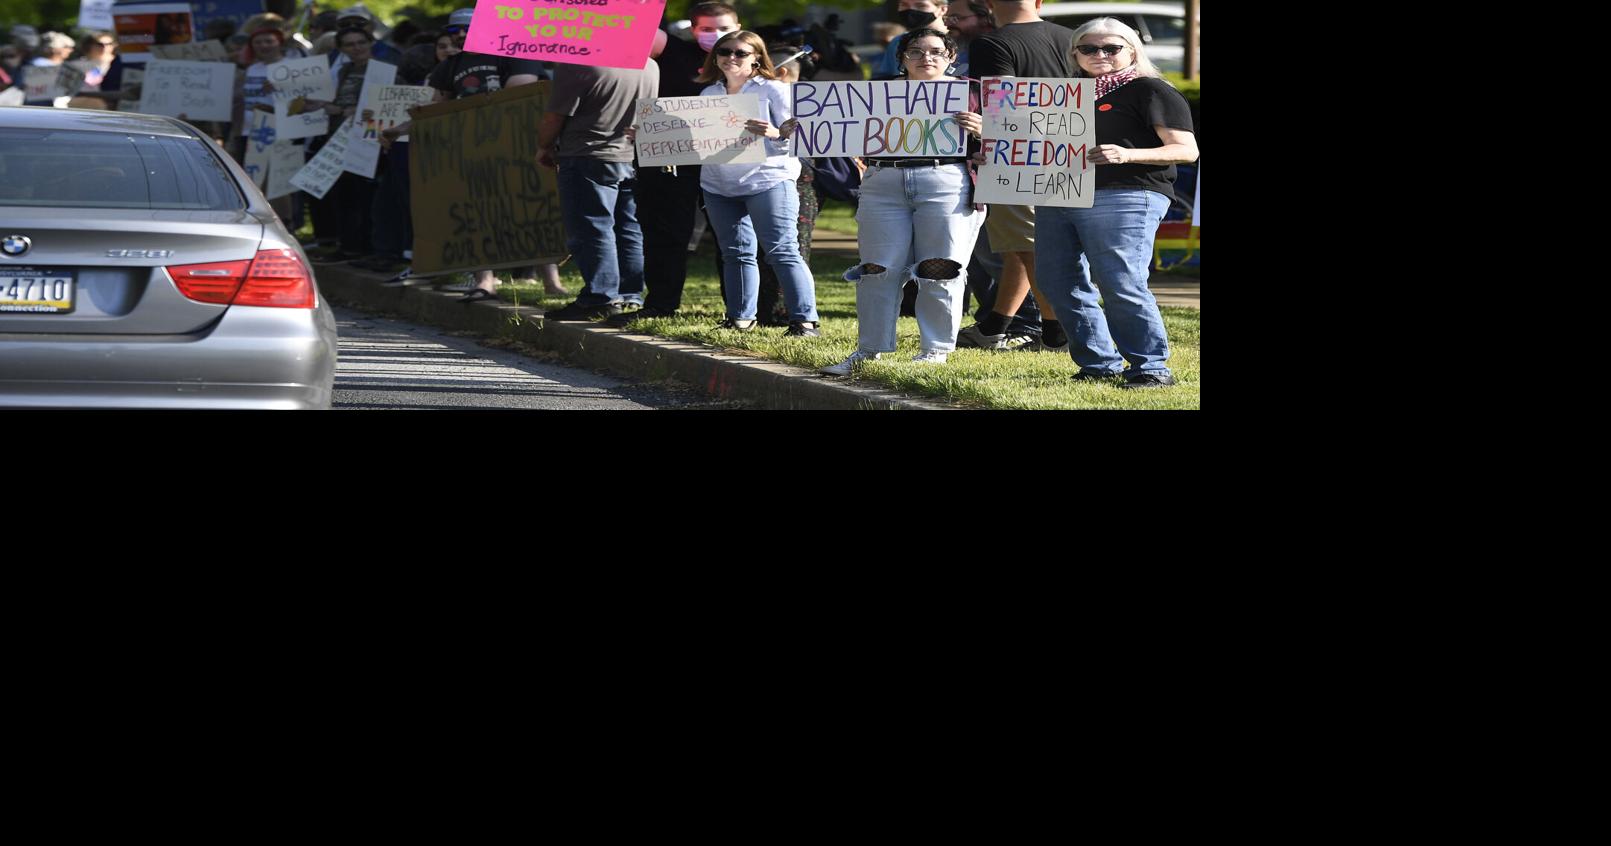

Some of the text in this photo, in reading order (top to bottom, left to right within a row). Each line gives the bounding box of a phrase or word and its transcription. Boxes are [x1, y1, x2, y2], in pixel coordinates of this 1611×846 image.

[495, 5, 636, 29] TO PROTECT
[497, 35, 592, 55] Ignorance
[525, 24, 593, 41] YOUR
[273, 65, 323, 84] Open
[378, 87, 428, 101] LIBRARIES
[653, 97, 730, 114] STUDENTS
[793, 81, 968, 118] BAN HATE
[982, 79, 1082, 110] FREEDOM
[643, 117, 709, 135] DESERVE
[794, 117, 965, 156] NOT BOOKS!
[1001, 111, 1086, 137] to READ
[981, 138, 1087, 169] FREEDOM
[996, 171, 1083, 200] to LEARN
[449, 192, 562, 235] SEXUALIZE
[443, 238, 480, 264] OUR
